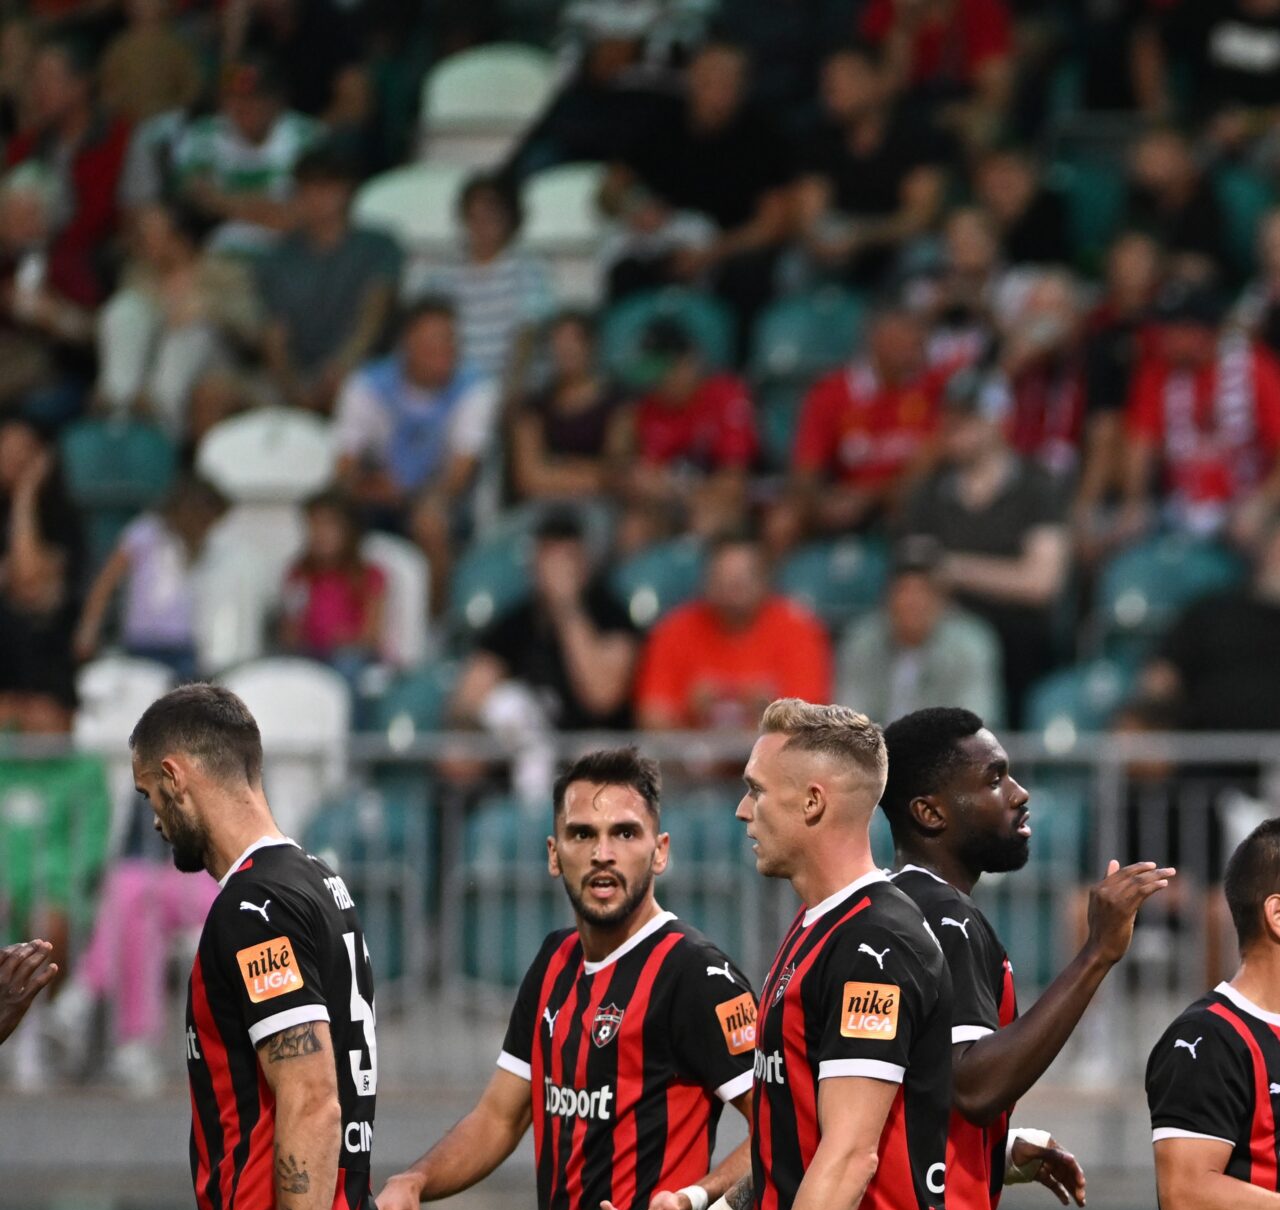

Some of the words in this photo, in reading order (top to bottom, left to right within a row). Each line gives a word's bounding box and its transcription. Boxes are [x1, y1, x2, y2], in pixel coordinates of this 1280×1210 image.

[247, 944, 290, 978] niké
[253, 968, 298, 995] LIGA
[726, 1000, 756, 1032] niké
[848, 990, 894, 1015] niké
[847, 1014, 893, 1032] LIGA
